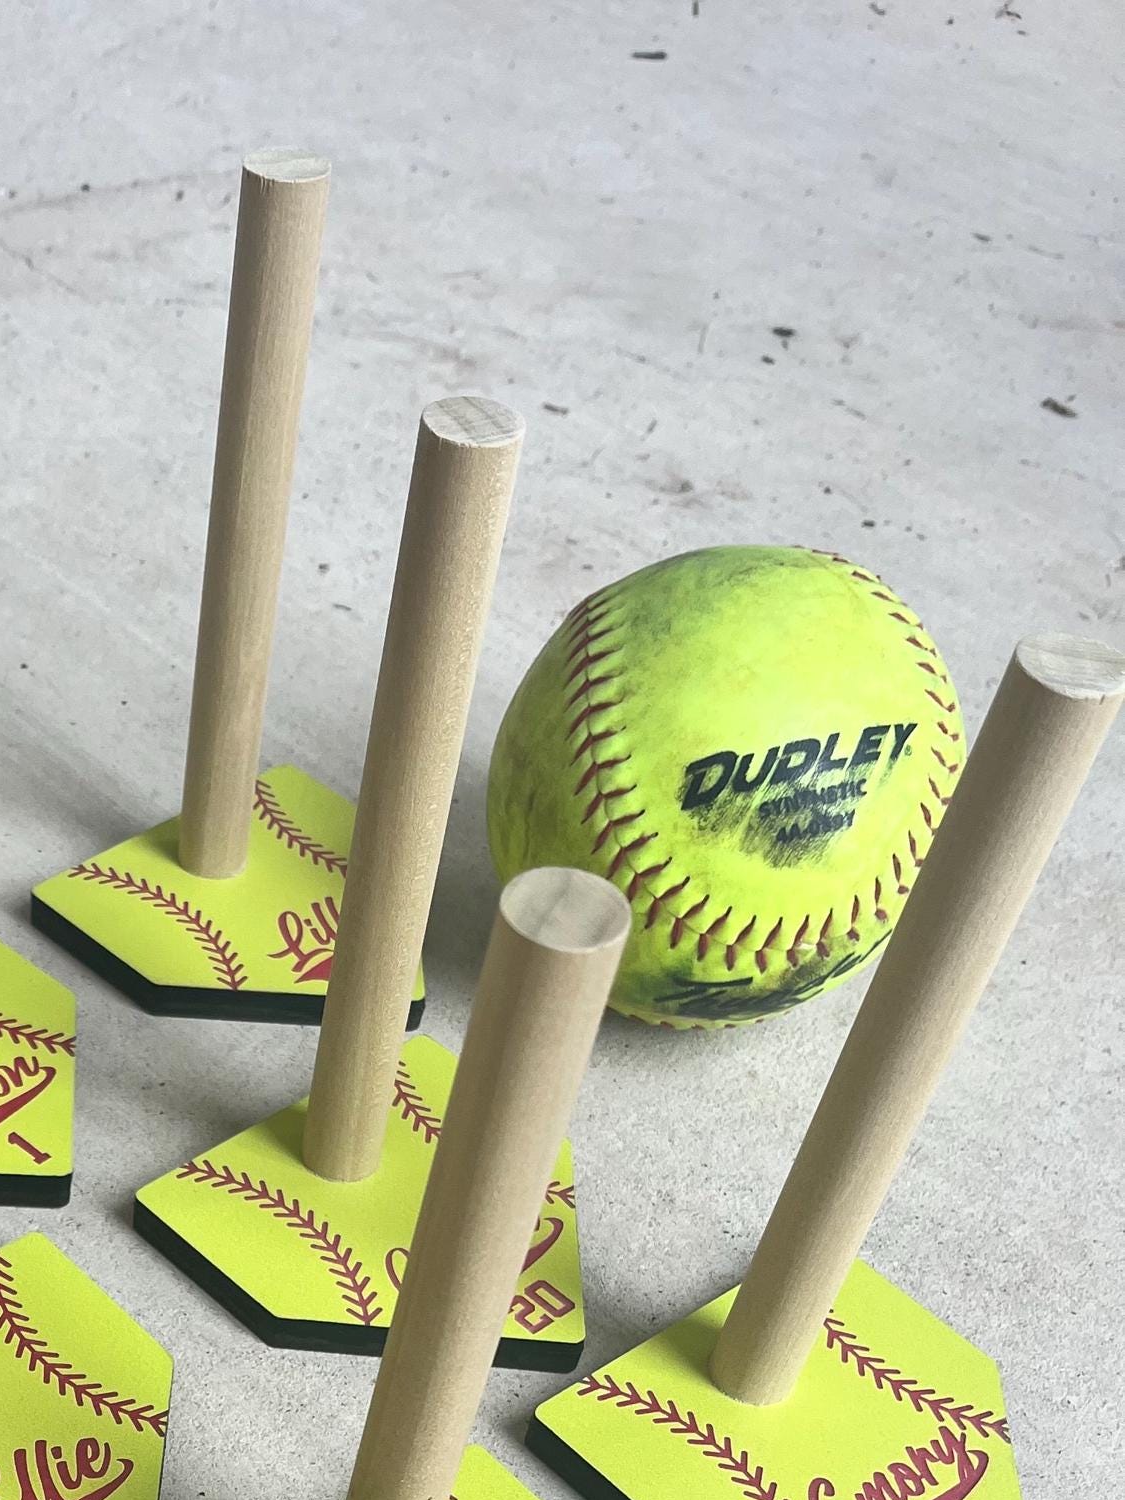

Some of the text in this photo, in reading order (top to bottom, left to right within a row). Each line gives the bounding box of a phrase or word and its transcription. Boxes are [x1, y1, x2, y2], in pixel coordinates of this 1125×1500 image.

[681, 723, 918, 810] DUDLEY
[758, 777, 867, 819] SYNETIC
[8, 1131, 52, 1165] 1
[508, 1280, 576, 1335] 20
